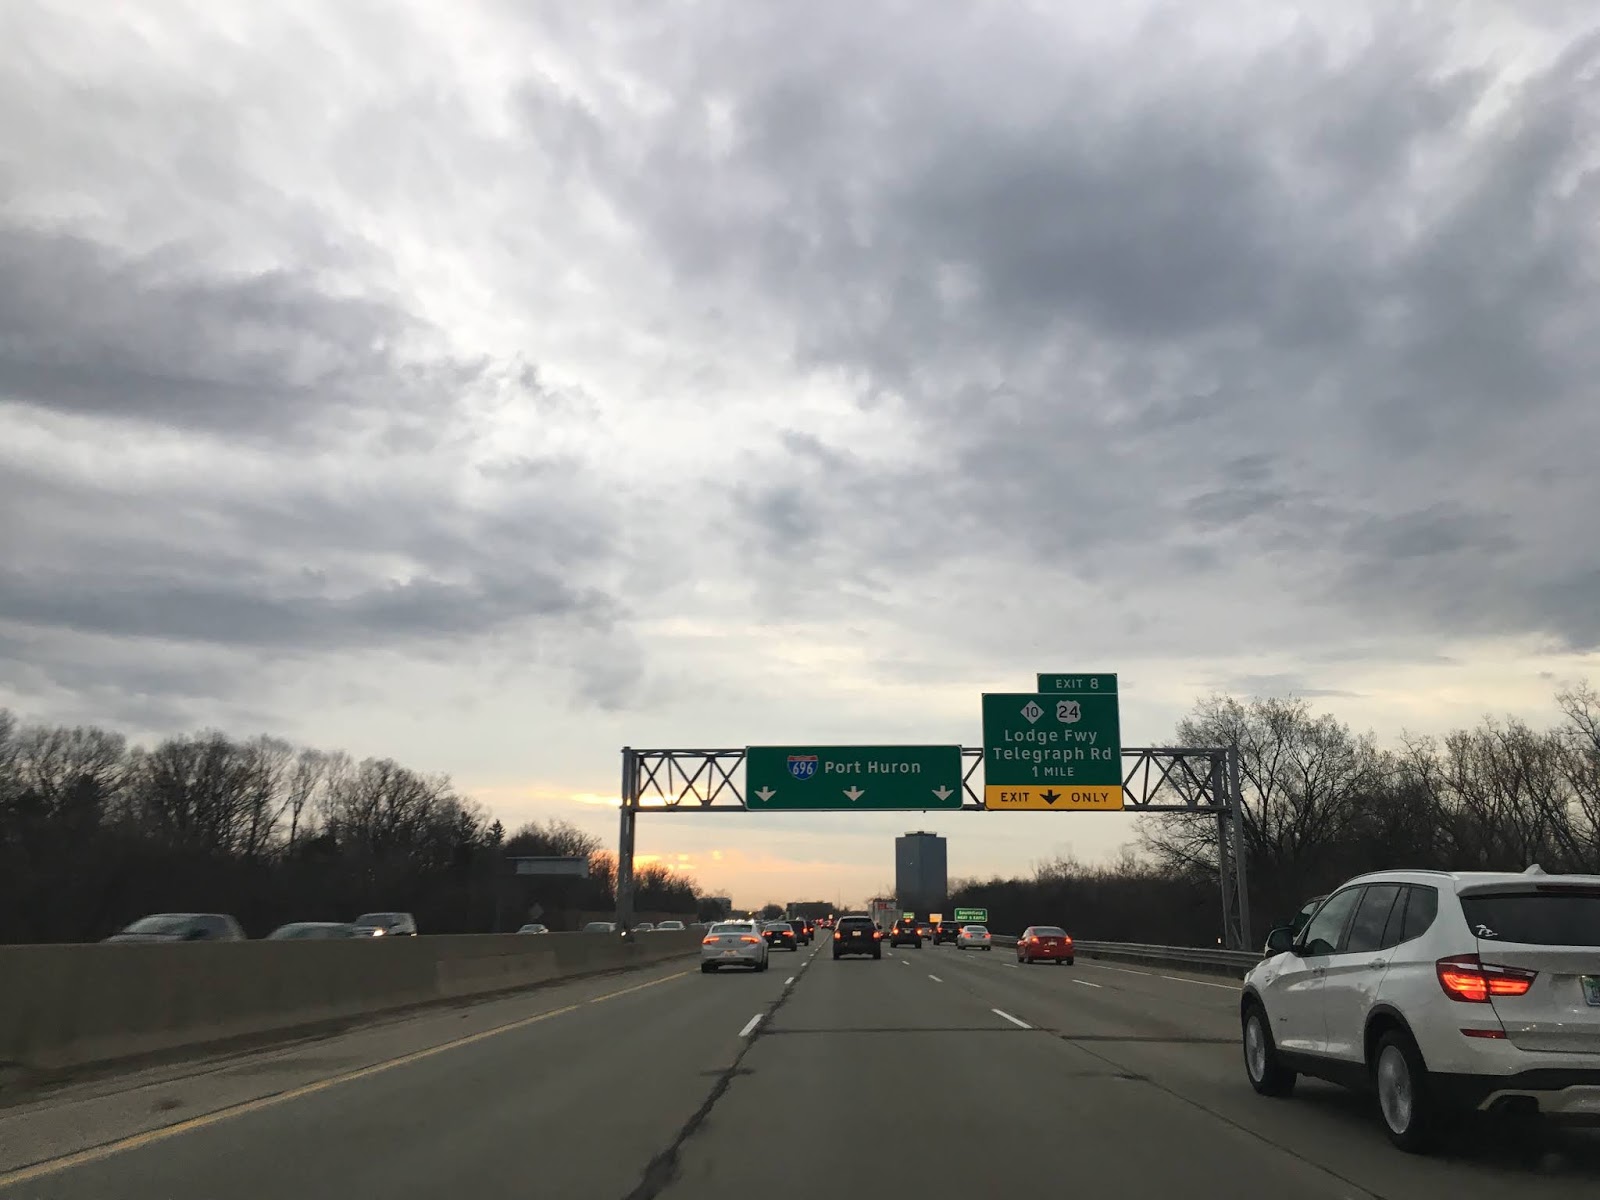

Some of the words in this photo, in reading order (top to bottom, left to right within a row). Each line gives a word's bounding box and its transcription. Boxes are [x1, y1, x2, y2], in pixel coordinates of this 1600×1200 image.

[1056, 679, 1083, 689] EXIT
[1090, 677, 1099, 690] 8
[1025, 706, 1039, 718] 10
[1058, 705, 1079, 719] 24
[1004, 728, 1059, 745] Lodge
[1064, 729, 1098, 745] Fwy
[992, 746, 1084, 763] Telegraph
[1090, 746, 1112, 760] Rd
[792, 761, 813, 775] 696
[824, 760, 861, 774] Port
[867, 760, 921, 774] Huron
[1031, 765, 1039, 778] 1
[1044, 767, 1075, 777] MILE
[1000, 792, 1030, 802] EXIT
[1071, 792, 1110, 802] ONLY
